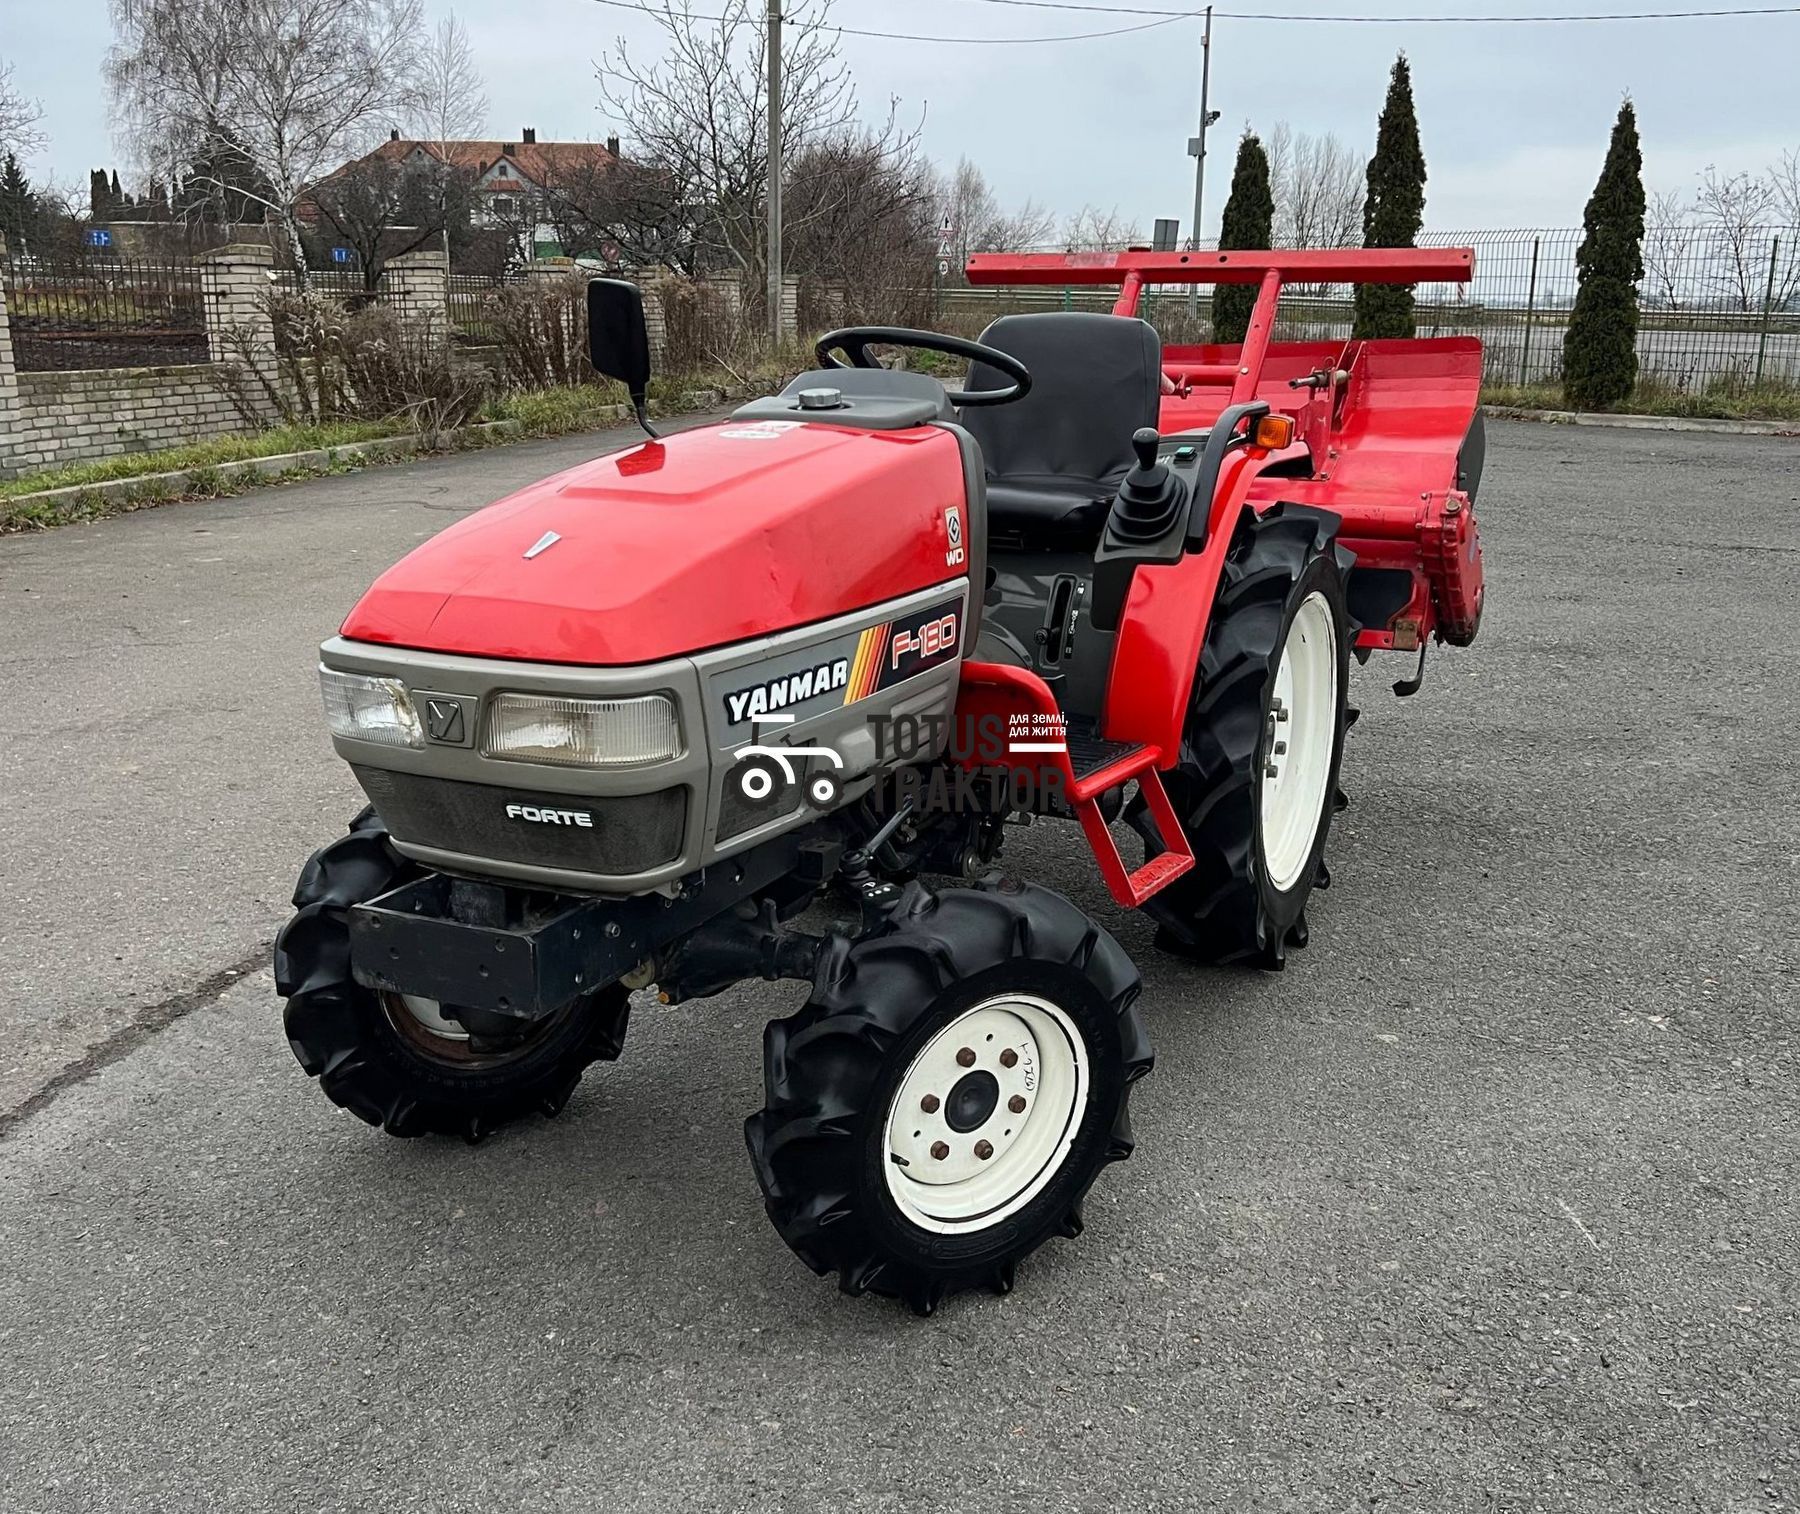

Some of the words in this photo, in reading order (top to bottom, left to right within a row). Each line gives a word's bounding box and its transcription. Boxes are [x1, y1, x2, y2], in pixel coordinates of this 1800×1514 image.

[946, 547, 964, 567] WD
[892, 613, 956, 670] F-180
[728, 659, 848, 722] YANMAR
[506, 805, 593, 827] FORTE
